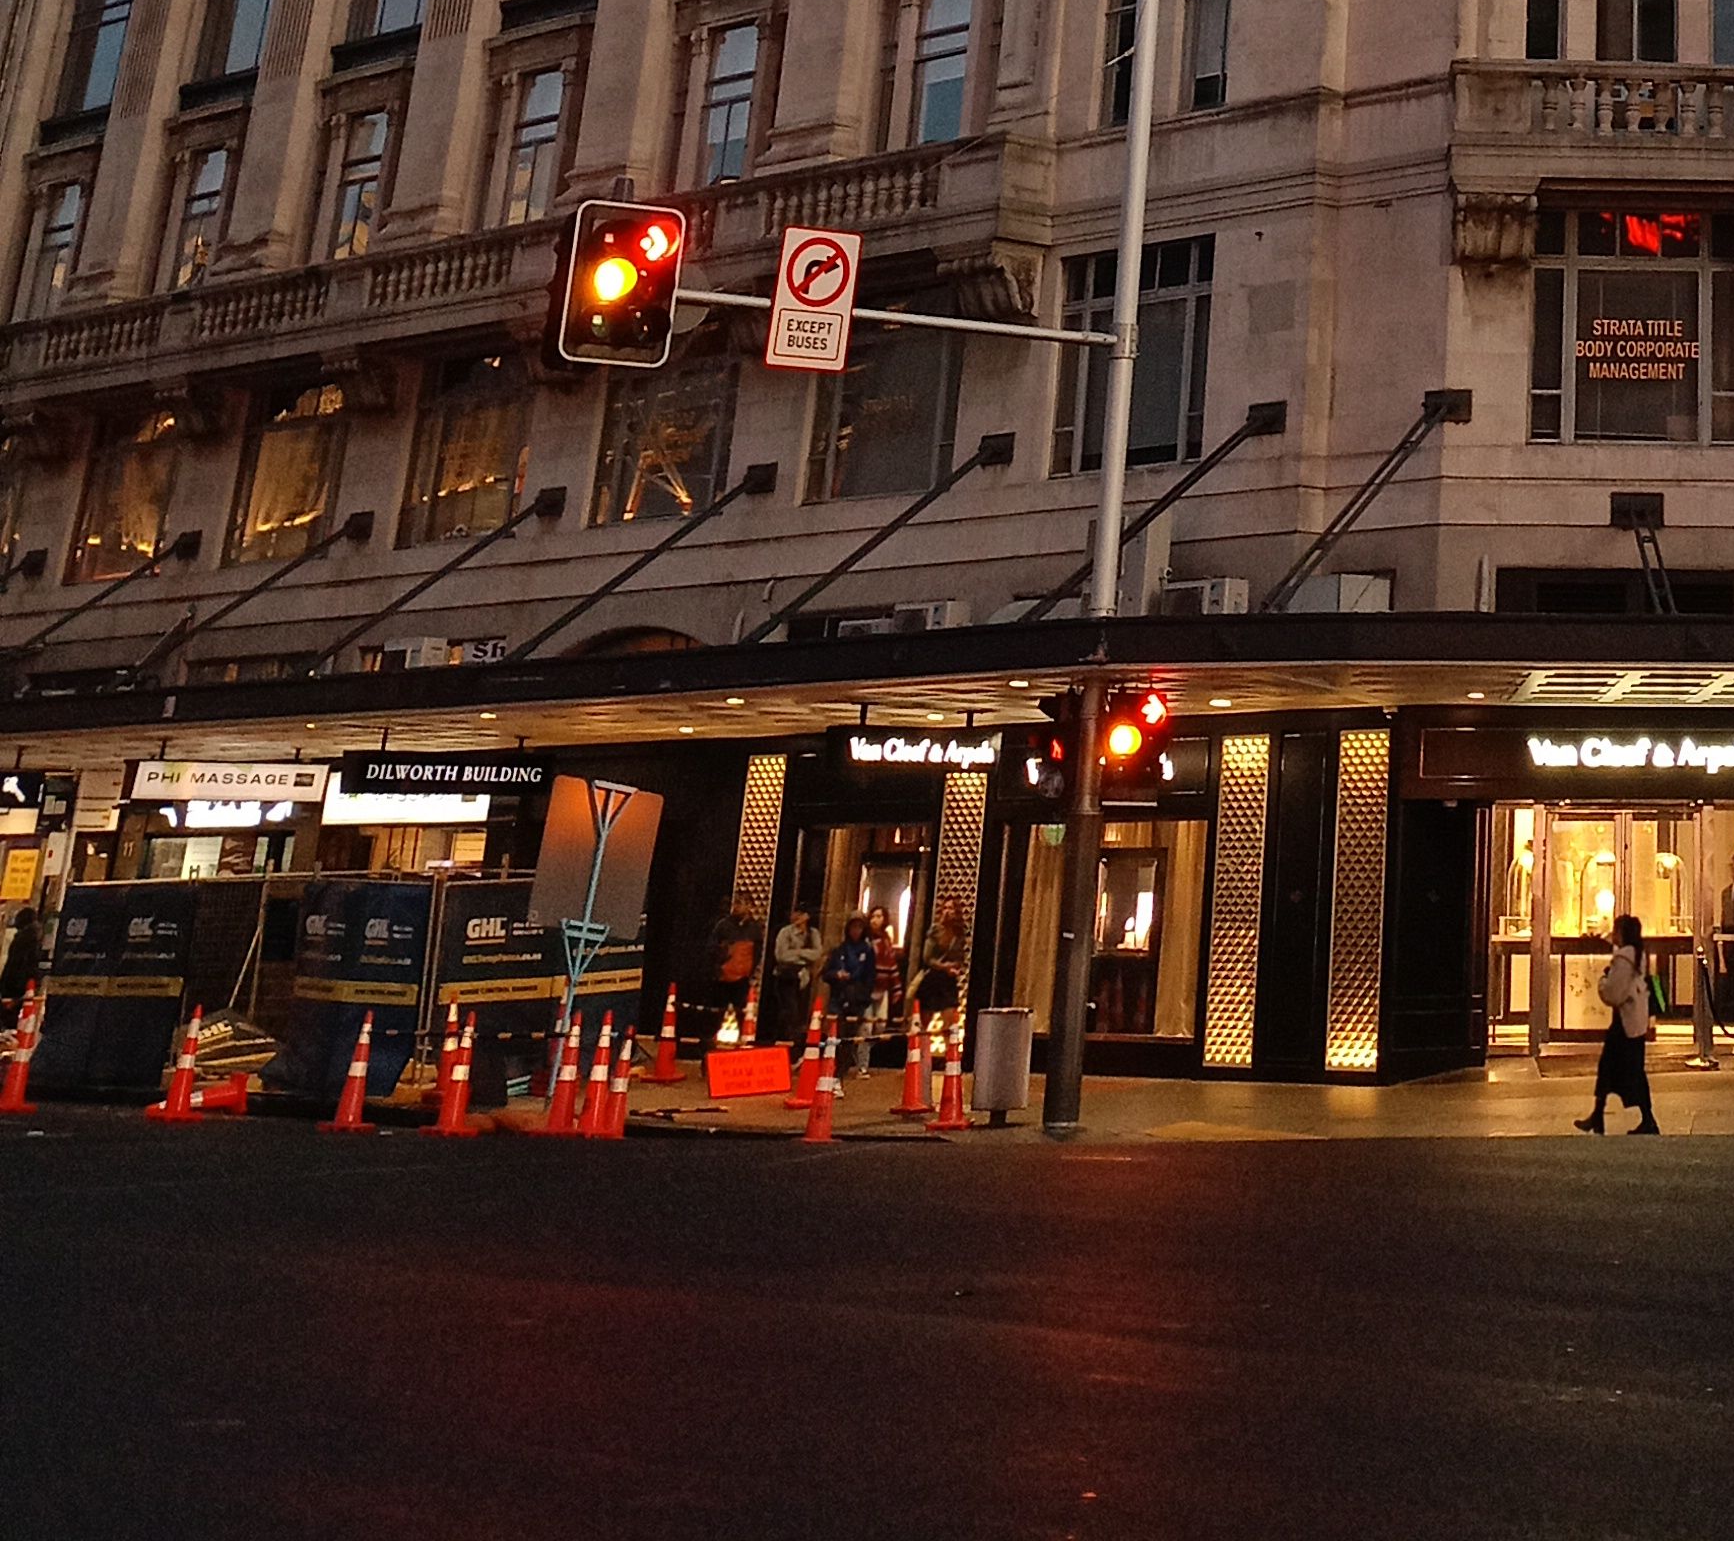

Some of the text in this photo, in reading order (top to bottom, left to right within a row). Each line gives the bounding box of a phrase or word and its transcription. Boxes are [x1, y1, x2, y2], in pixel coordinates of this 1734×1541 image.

[787, 319, 833, 334] EXCEPT
[1592, 319, 1683, 337] STRATA TITLE
[787, 335, 828, 350] BUSES
[1576, 341, 1700, 359] BODY CORPORATE
[1589, 362, 1685, 380] MANAGEMENT
[147, 771, 181, 784] PHI
[190, 771, 289, 786] MASSAGE
[366, 764, 543, 783] DILWORTH BUILDING
